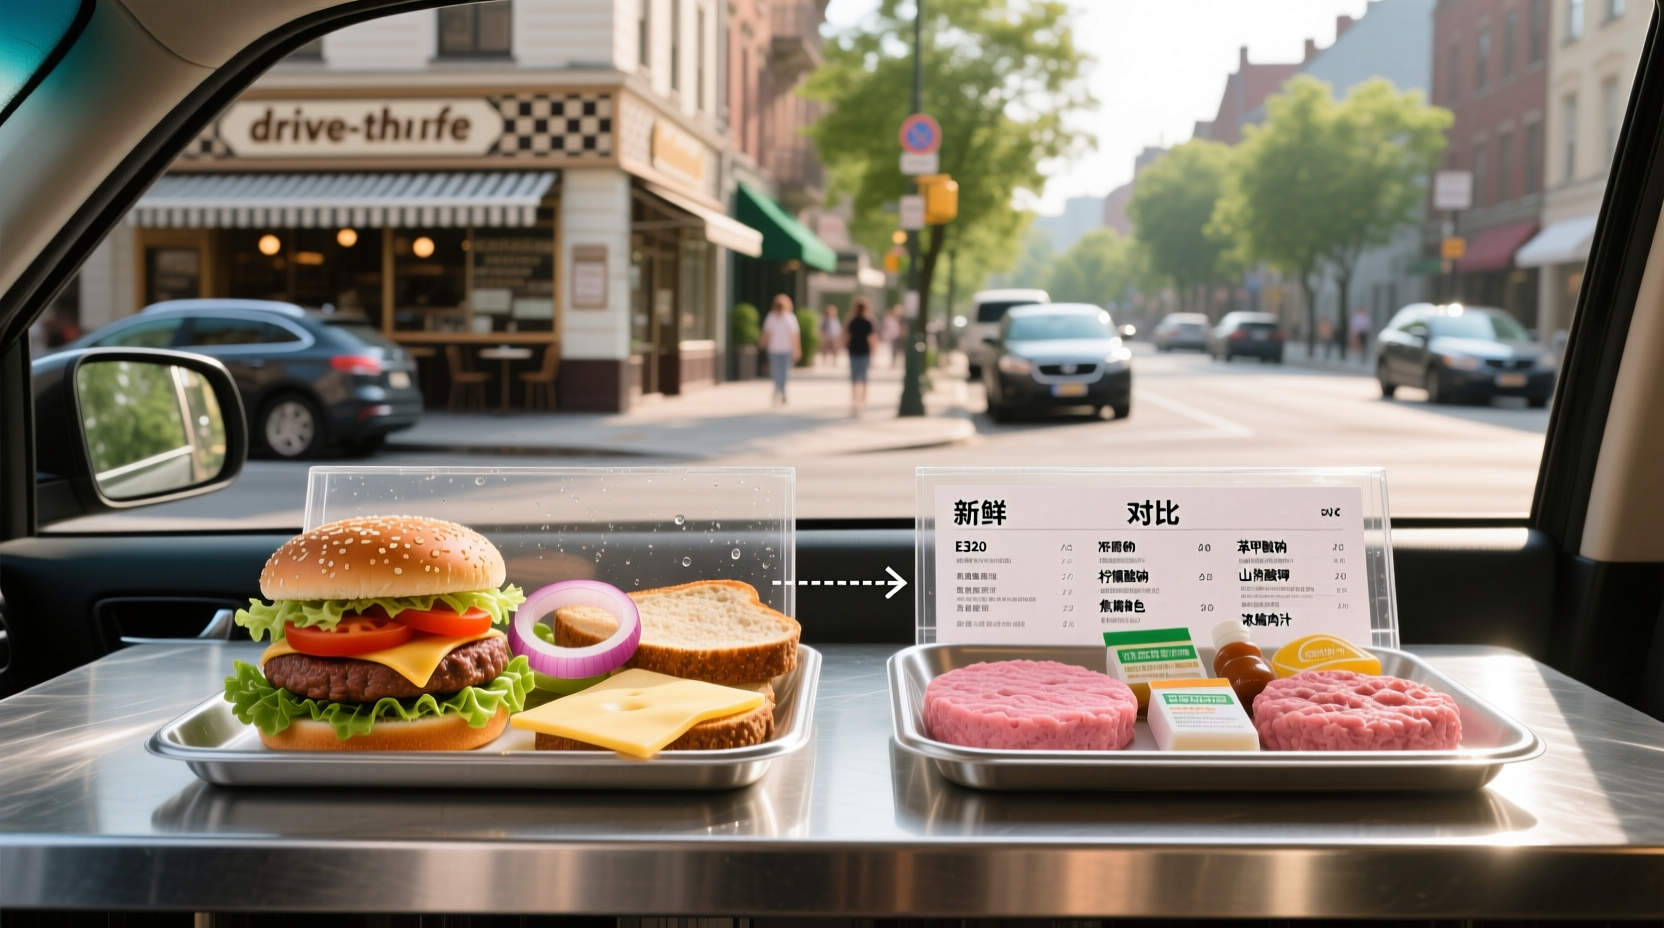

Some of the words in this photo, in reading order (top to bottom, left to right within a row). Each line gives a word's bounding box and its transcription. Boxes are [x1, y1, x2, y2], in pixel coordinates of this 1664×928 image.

[953, 499, 1007, 526] 新鲜
[1126, 499, 1180, 526] 对比
[955, 540, 987, 553] E320
